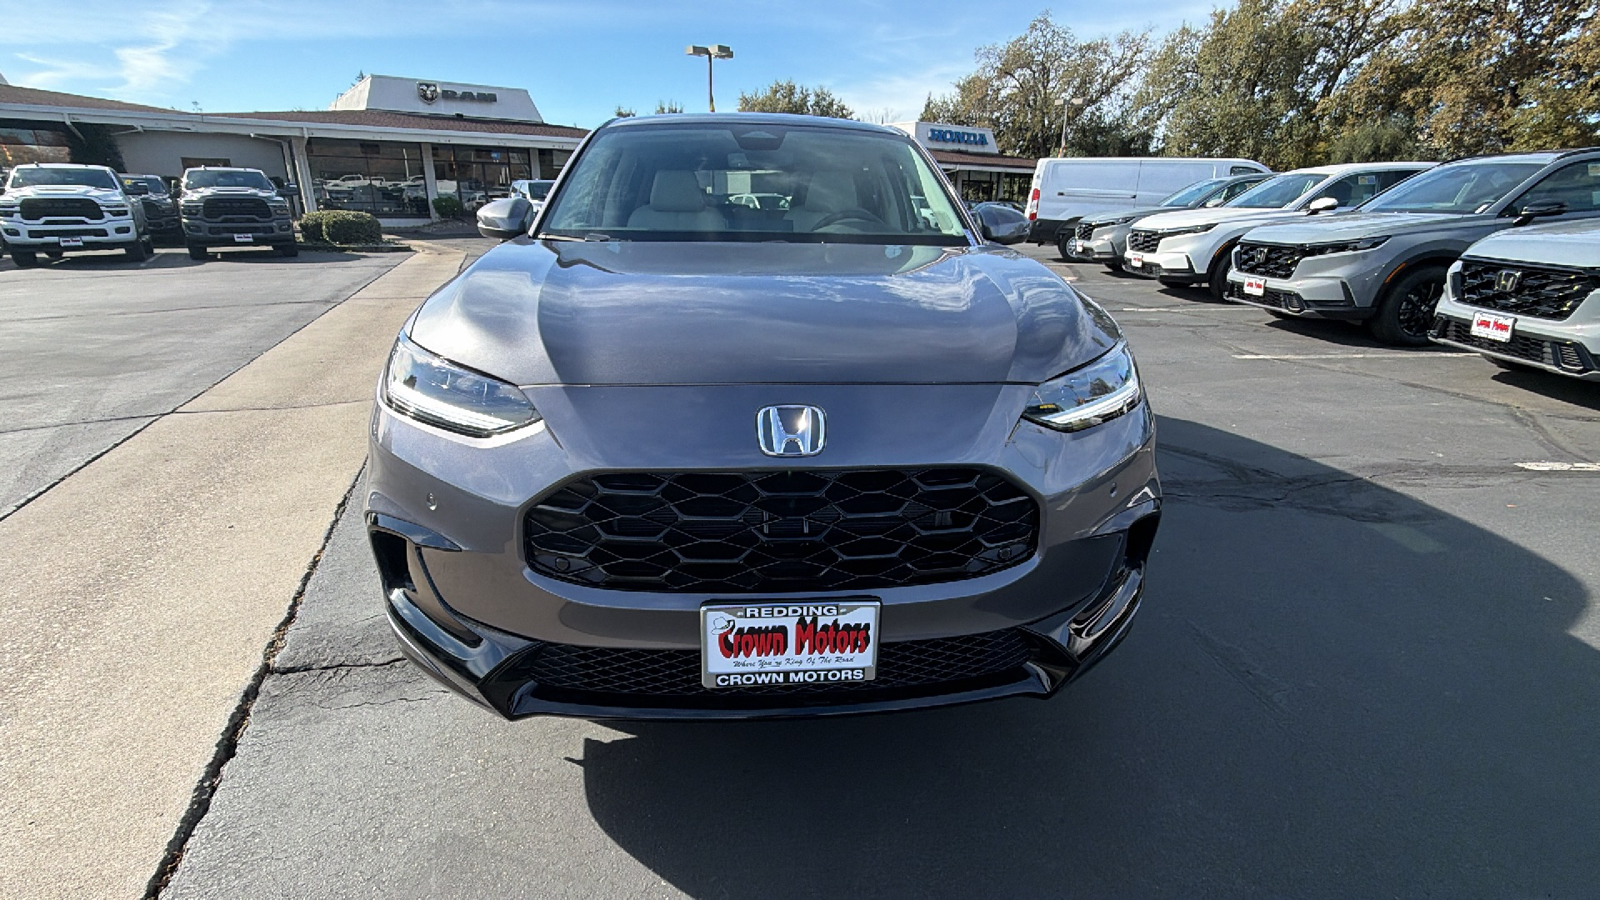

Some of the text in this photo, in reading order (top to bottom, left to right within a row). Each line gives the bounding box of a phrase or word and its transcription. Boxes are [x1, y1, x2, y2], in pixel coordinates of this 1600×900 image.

[441, 89, 498, 103] RAM
[927, 128, 989, 146] HONDA
[745, 606, 838, 618] REDDING
[718, 616, 870, 659] Crown Motors
[733, 660, 756, 668] Where
[784, 658, 803, 667] King
[806, 656, 816, 665] Of
[819, 656, 832, 664] The
[834, 655, 856, 663] Road
[716, 669, 864, 687] CROWN MOTORS
